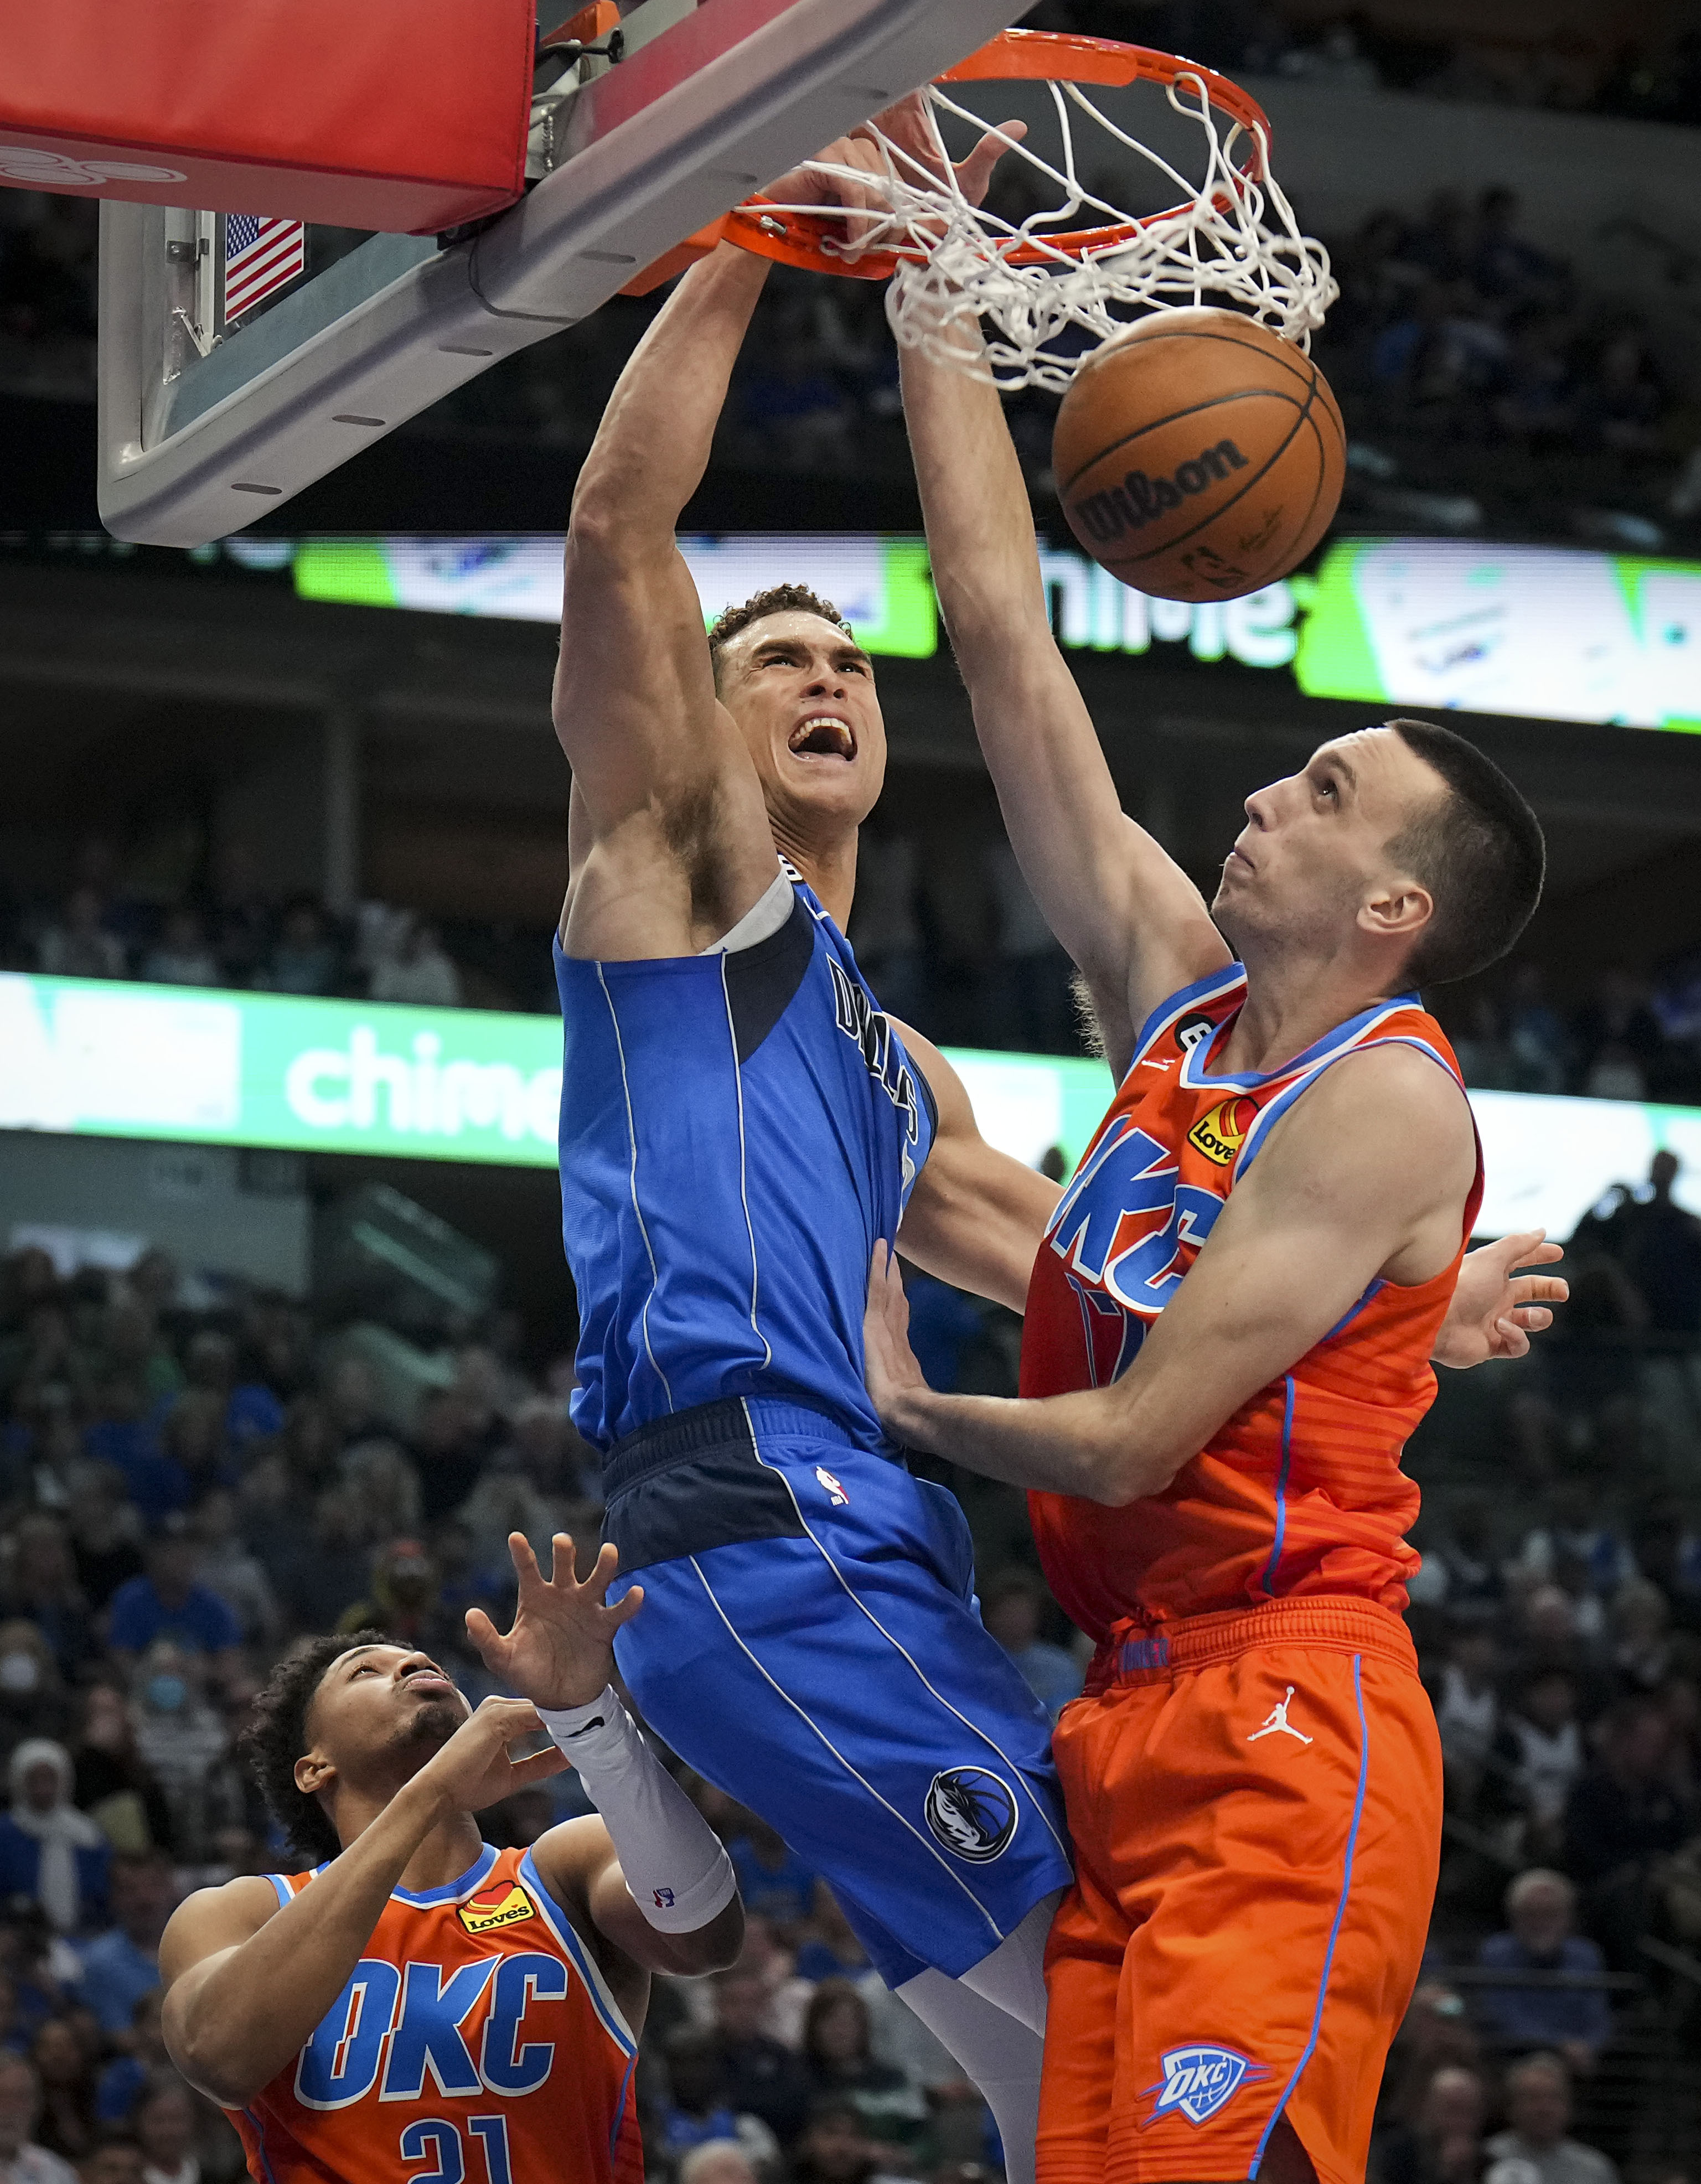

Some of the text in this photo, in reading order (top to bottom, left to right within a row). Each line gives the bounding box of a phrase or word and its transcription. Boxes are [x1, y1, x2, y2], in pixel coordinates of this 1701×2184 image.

[1074, 439, 1249, 542] Wilson
[293, 1952, 568, 2111] OKC
[1159, 2062, 1227, 2107] OKC
[400, 2114, 513, 2184] 21
